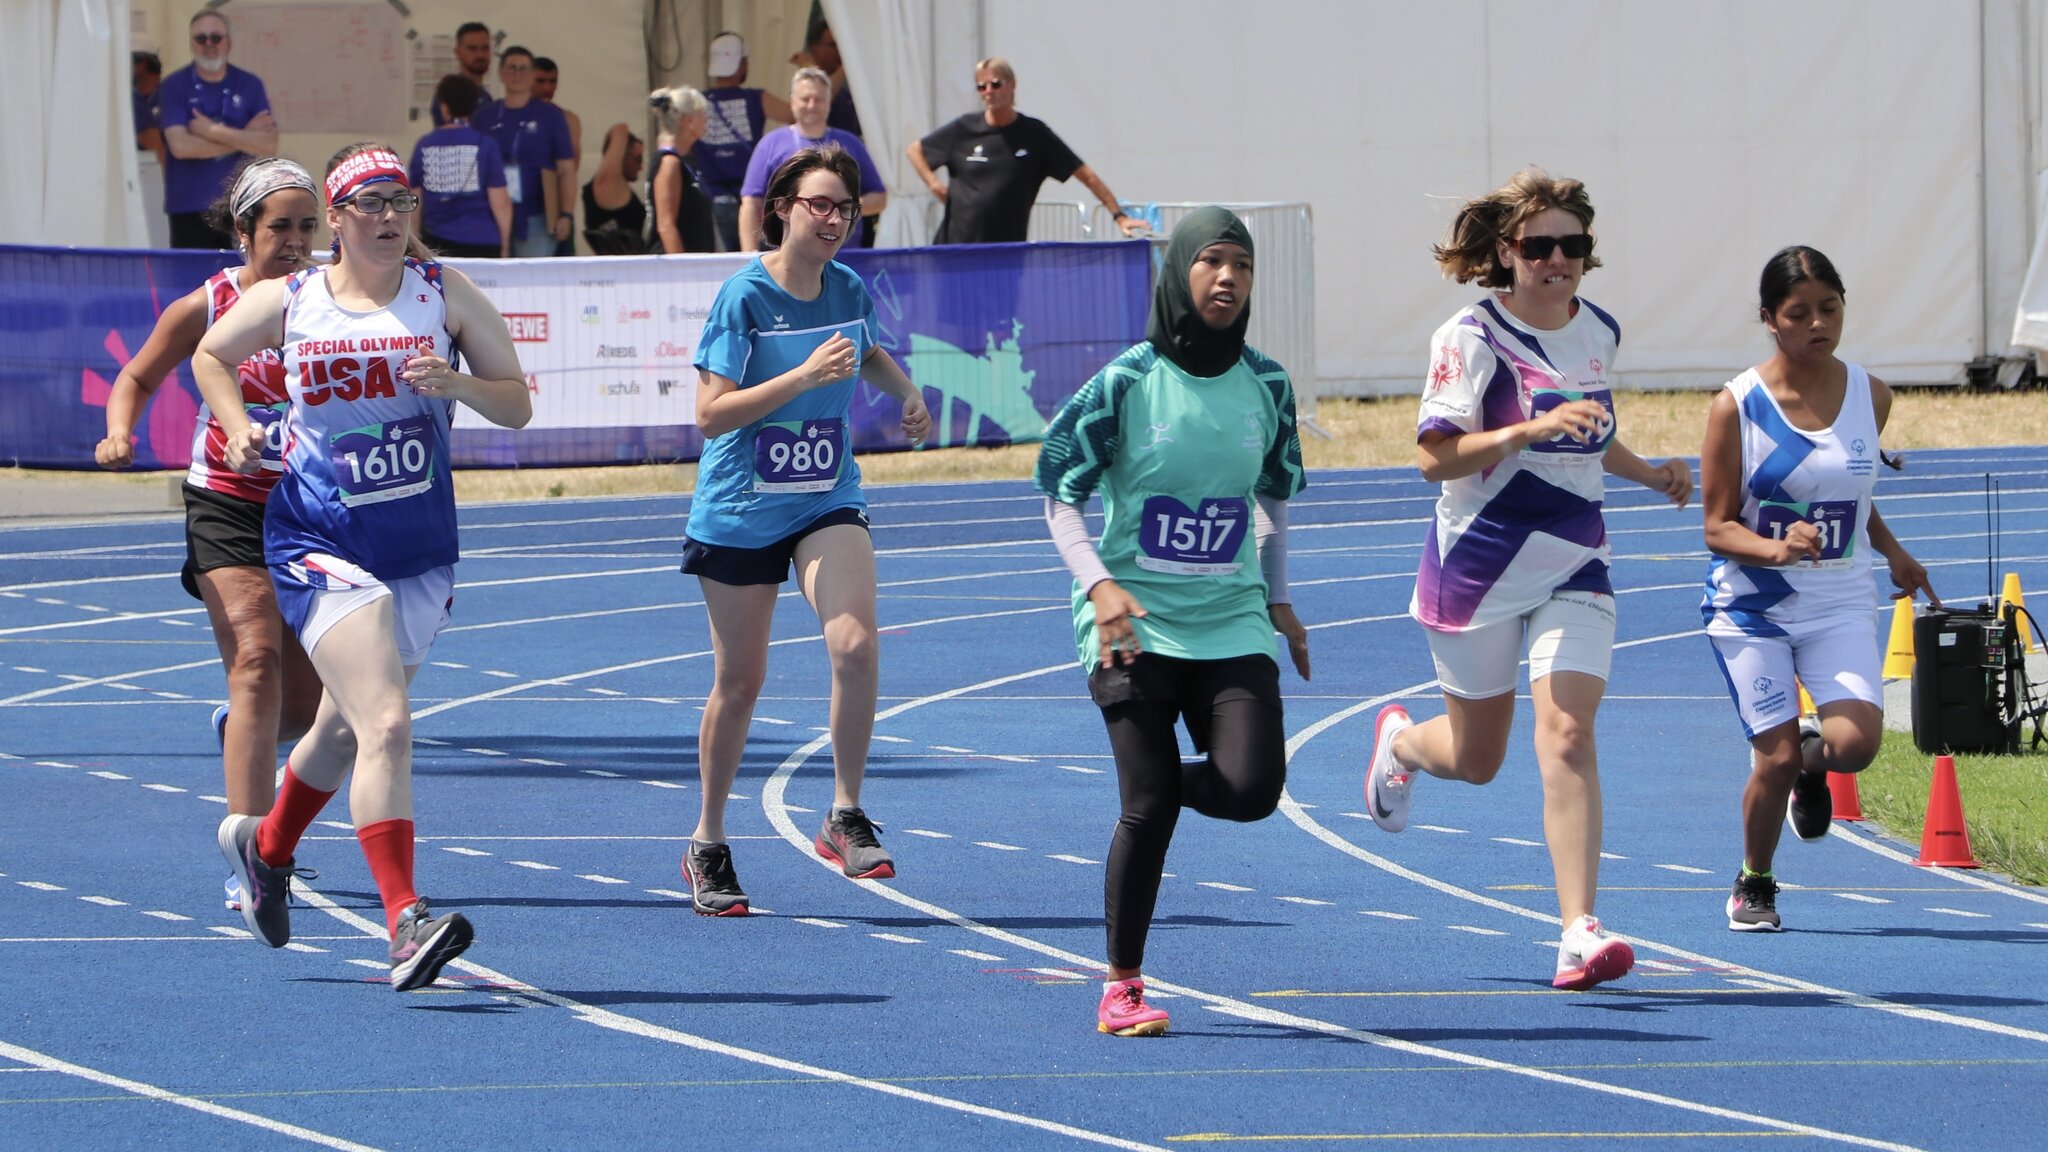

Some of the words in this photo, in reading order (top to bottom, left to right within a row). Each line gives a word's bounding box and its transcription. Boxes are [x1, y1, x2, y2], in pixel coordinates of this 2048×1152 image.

[326, 153, 373, 189] SPECIAL
[298, 339, 357, 357] SPECIAL
[360, 335, 435, 352] OLYMPICS
[298, 356, 397, 407] USA
[344, 438, 425, 484] 1610
[769, 438, 834, 473] 980
[1156, 513, 1237, 552] 1517
